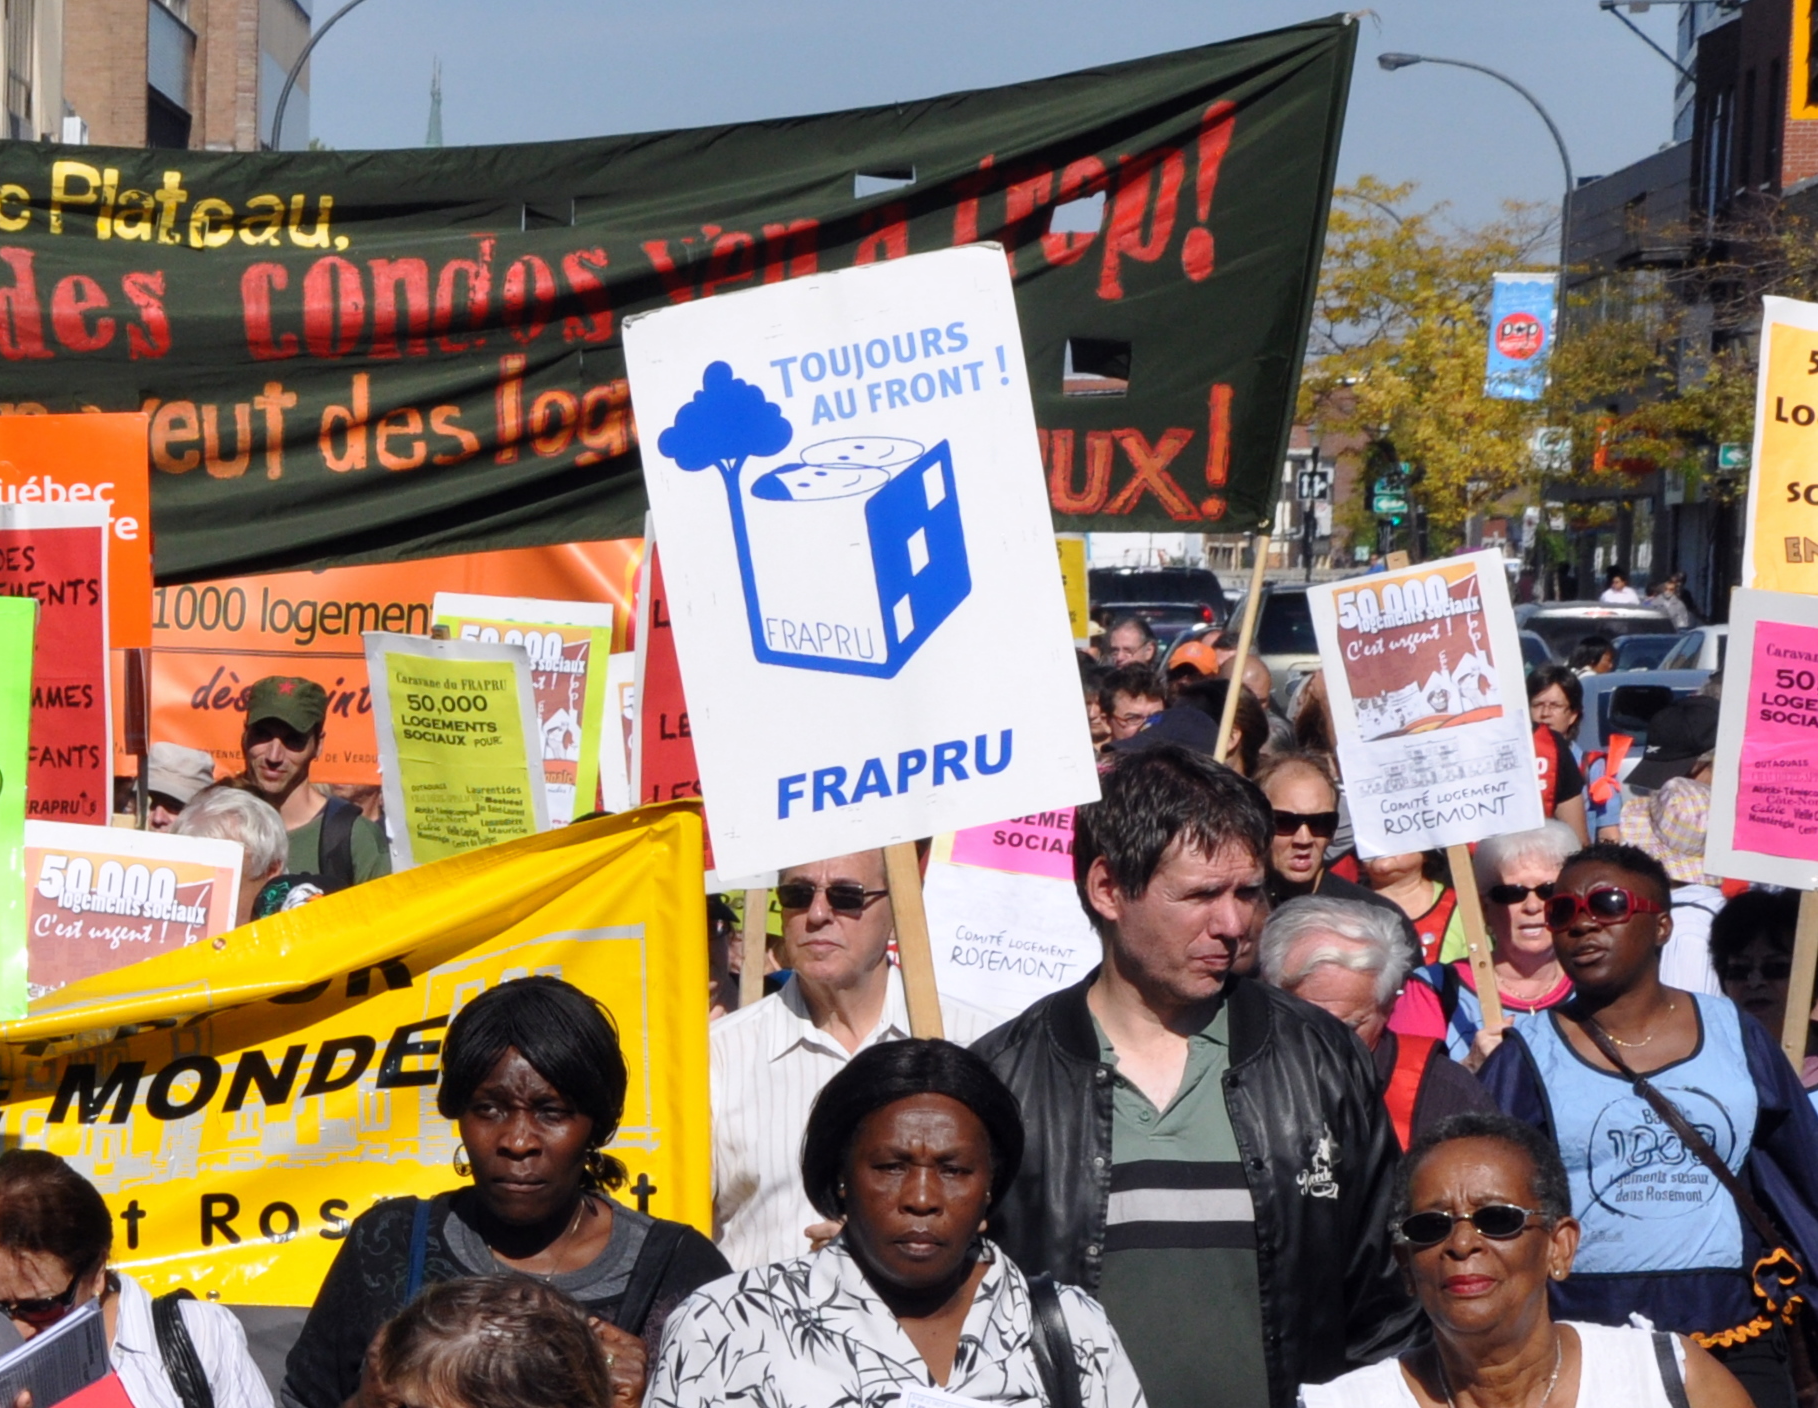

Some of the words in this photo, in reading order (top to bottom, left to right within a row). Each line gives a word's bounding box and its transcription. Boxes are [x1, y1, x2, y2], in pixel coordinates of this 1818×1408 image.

[239, 233, 614, 362] condos
[771, 321, 969, 398] TOUJOURS
[811, 391, 857, 426] AU
[868, 361, 984, 414] FRONT
[318, 374, 481, 473] des
[490, 354, 640, 466] log
[152, 585, 247, 632] 1000
[259, 586, 436, 646] logemen
[1357, 606, 1425, 634] logements
[1425, 595, 1481, 620] sociaux
[764, 617, 875, 660] FRAPRU
[1347, 637, 1385, 661] C'est
[1389, 623, 1440, 655] urgent
[396, 672, 441, 690] Caravane
[444, 678, 459, 691] du
[461, 679, 508, 692] FRAPRU
[401, 714, 498, 733] LOGEMENTS
[407, 694, 489, 716] 50,000
[404, 729, 466, 746] SOCIAUX
[776, 728, 1014, 820] FRAPRU
[1437, 780, 1509, 803] LOGEMENT
[25, 798, 80, 815] RAPRU
[1384, 793, 1515, 837] ROSEMONT
[58, 886, 143, 916] logements
[143, 899, 207, 925] sociaux
[34, 913, 83, 938] C'est
[88, 922, 154, 950] urgent
[1009, 938, 1078, 959] LOGEMENT
[950, 945, 1078, 983] ROSEMONT
[46, 1014, 449, 1126] MONDE
[1615, 1188, 1644, 1203] dans
[1646, 1186, 1703, 1203] Rosemont
